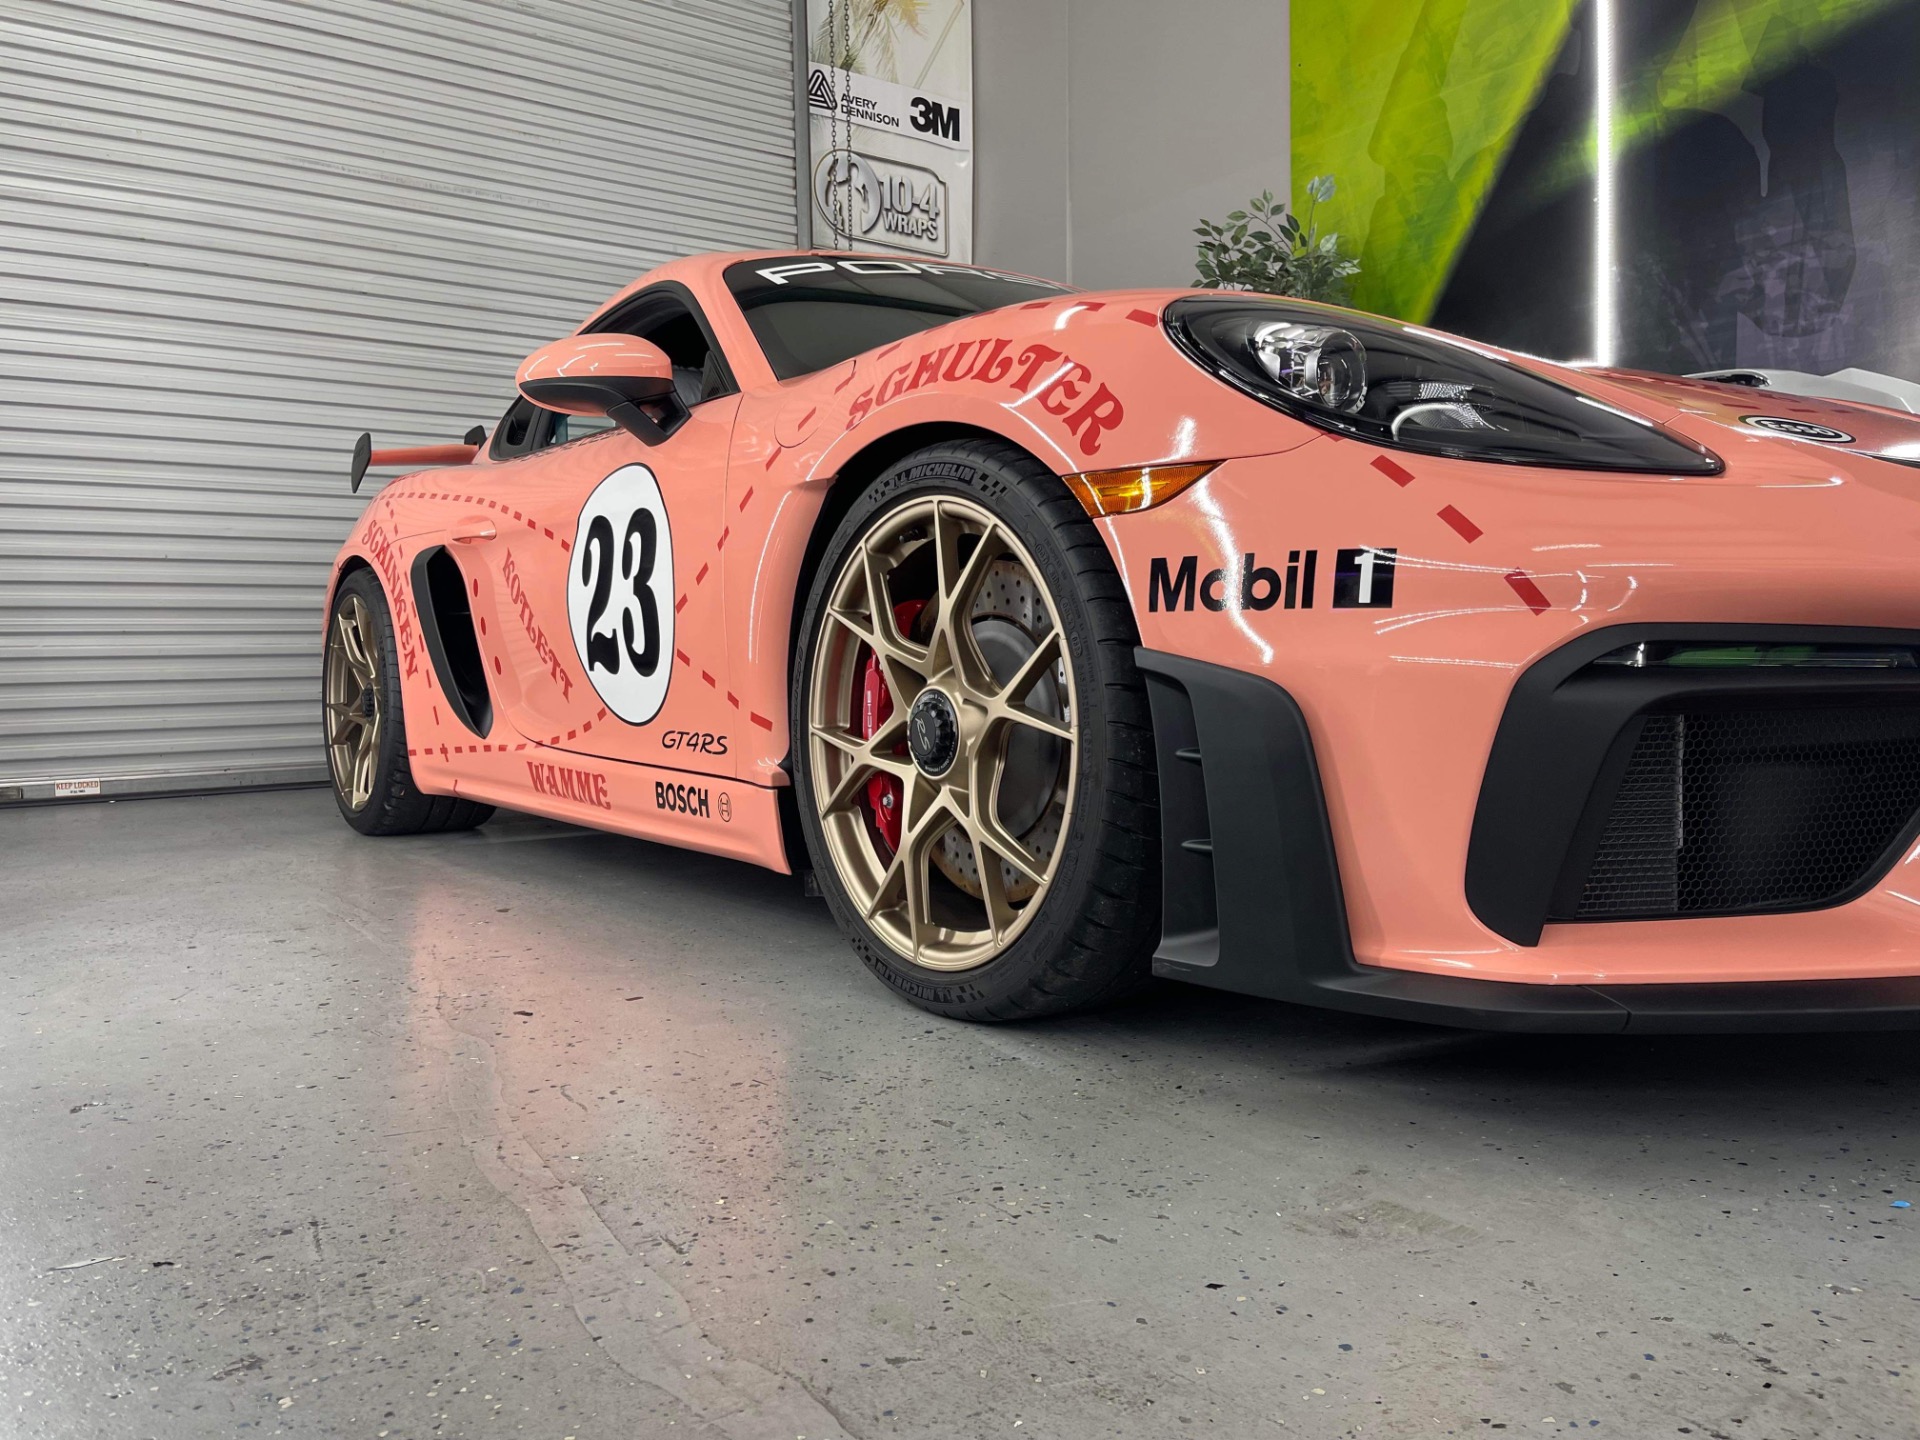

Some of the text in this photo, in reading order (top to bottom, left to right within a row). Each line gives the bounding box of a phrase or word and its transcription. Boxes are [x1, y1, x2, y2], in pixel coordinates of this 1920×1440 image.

[841, 93, 877, 110] AVERY
[841, 104, 900, 128] DENNISON
[909, 97, 960, 142] 3M
[880, 175, 940, 219] 10-4
[882, 211, 938, 241] WRAPS
[909, 463, 976, 481] MICHELIN
[582, 507, 661, 678] 23
[1149, 549, 1376, 613] Mobil 1
[526, 761, 612, 811] WAMME
[655, 781, 711, 819] BOSCH
[875, 959, 936, 1001] MICHELIN
